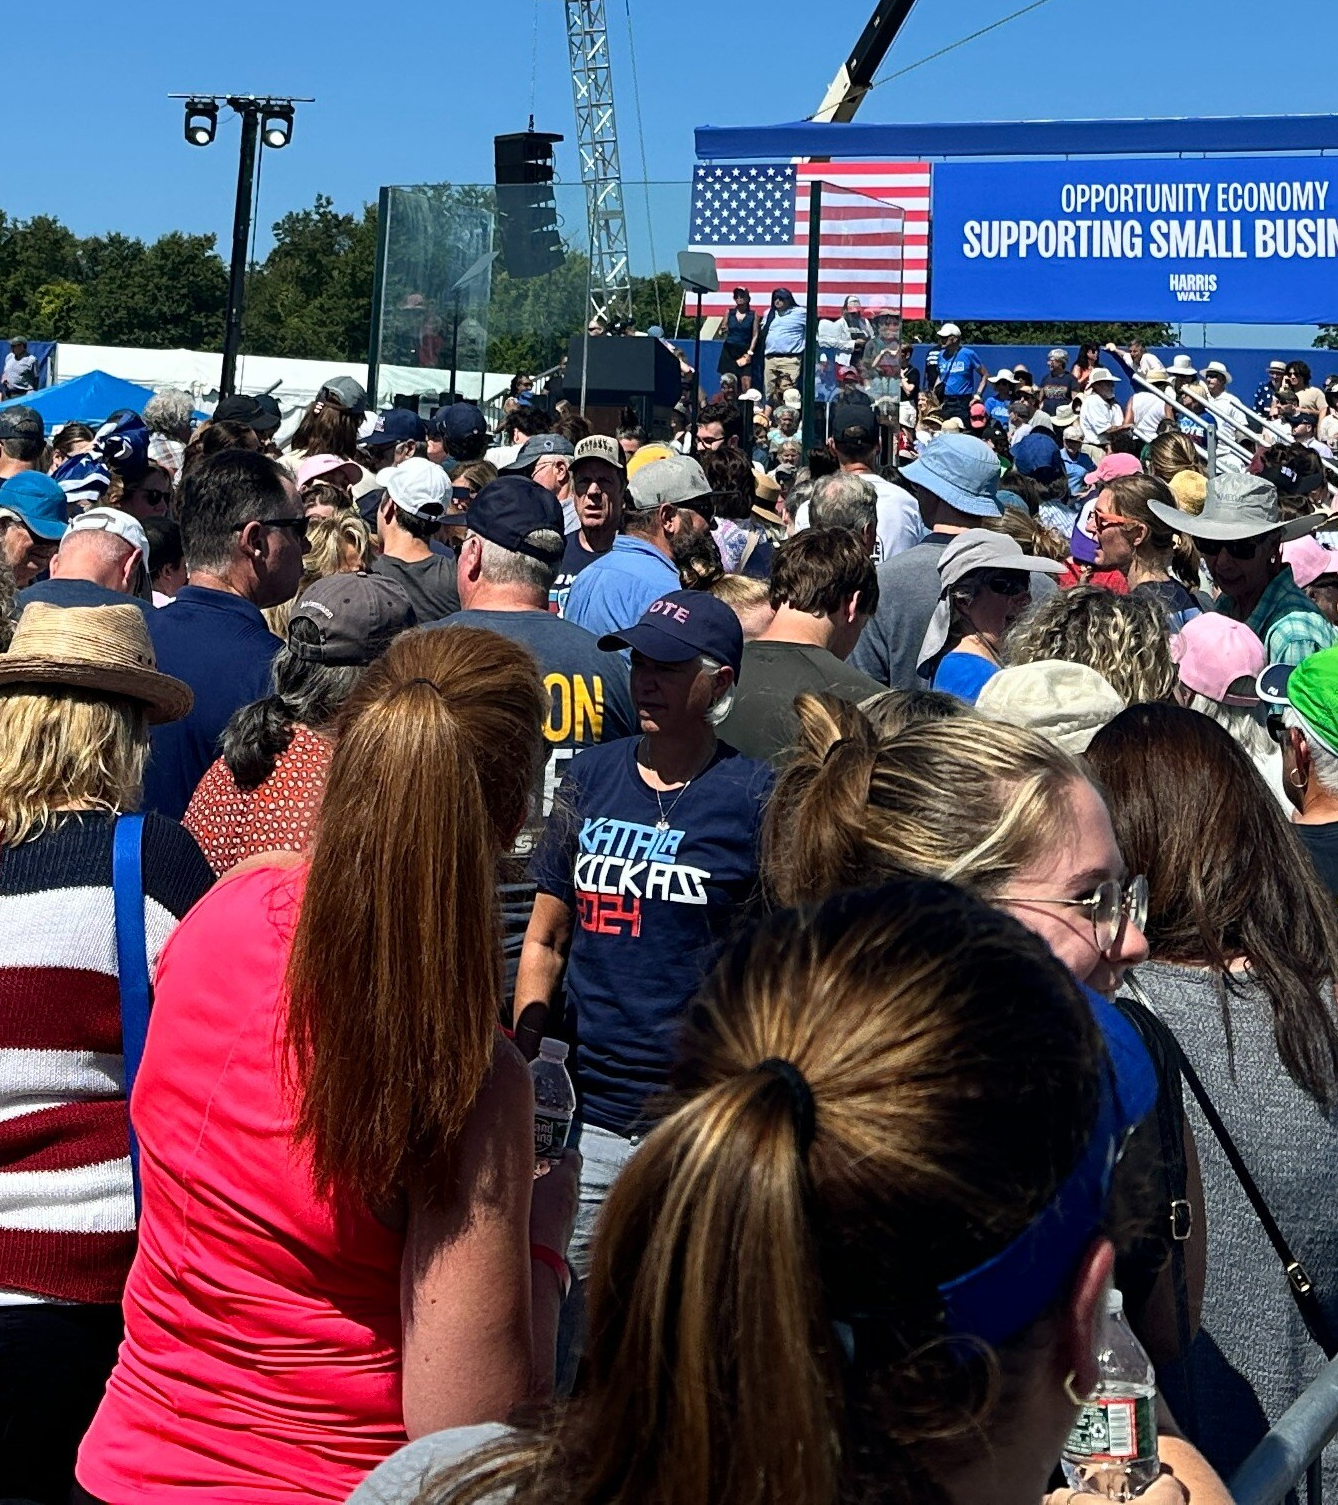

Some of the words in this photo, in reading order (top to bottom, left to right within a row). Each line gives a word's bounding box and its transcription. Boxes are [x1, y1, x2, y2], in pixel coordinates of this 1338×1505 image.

[1061, 183, 1211, 213] OPPORTUNITY
[1217, 181, 1330, 212] ECONOMY
[963, 219, 1143, 258] SUPPORTING
[1149, 219, 1248, 259] SMALL
[1169, 274, 1218, 291] HARRIS
[1176, 291, 1211, 302] WALZ
[649, 600, 690, 625] OTE
[542, 672, 604, 743] ON
